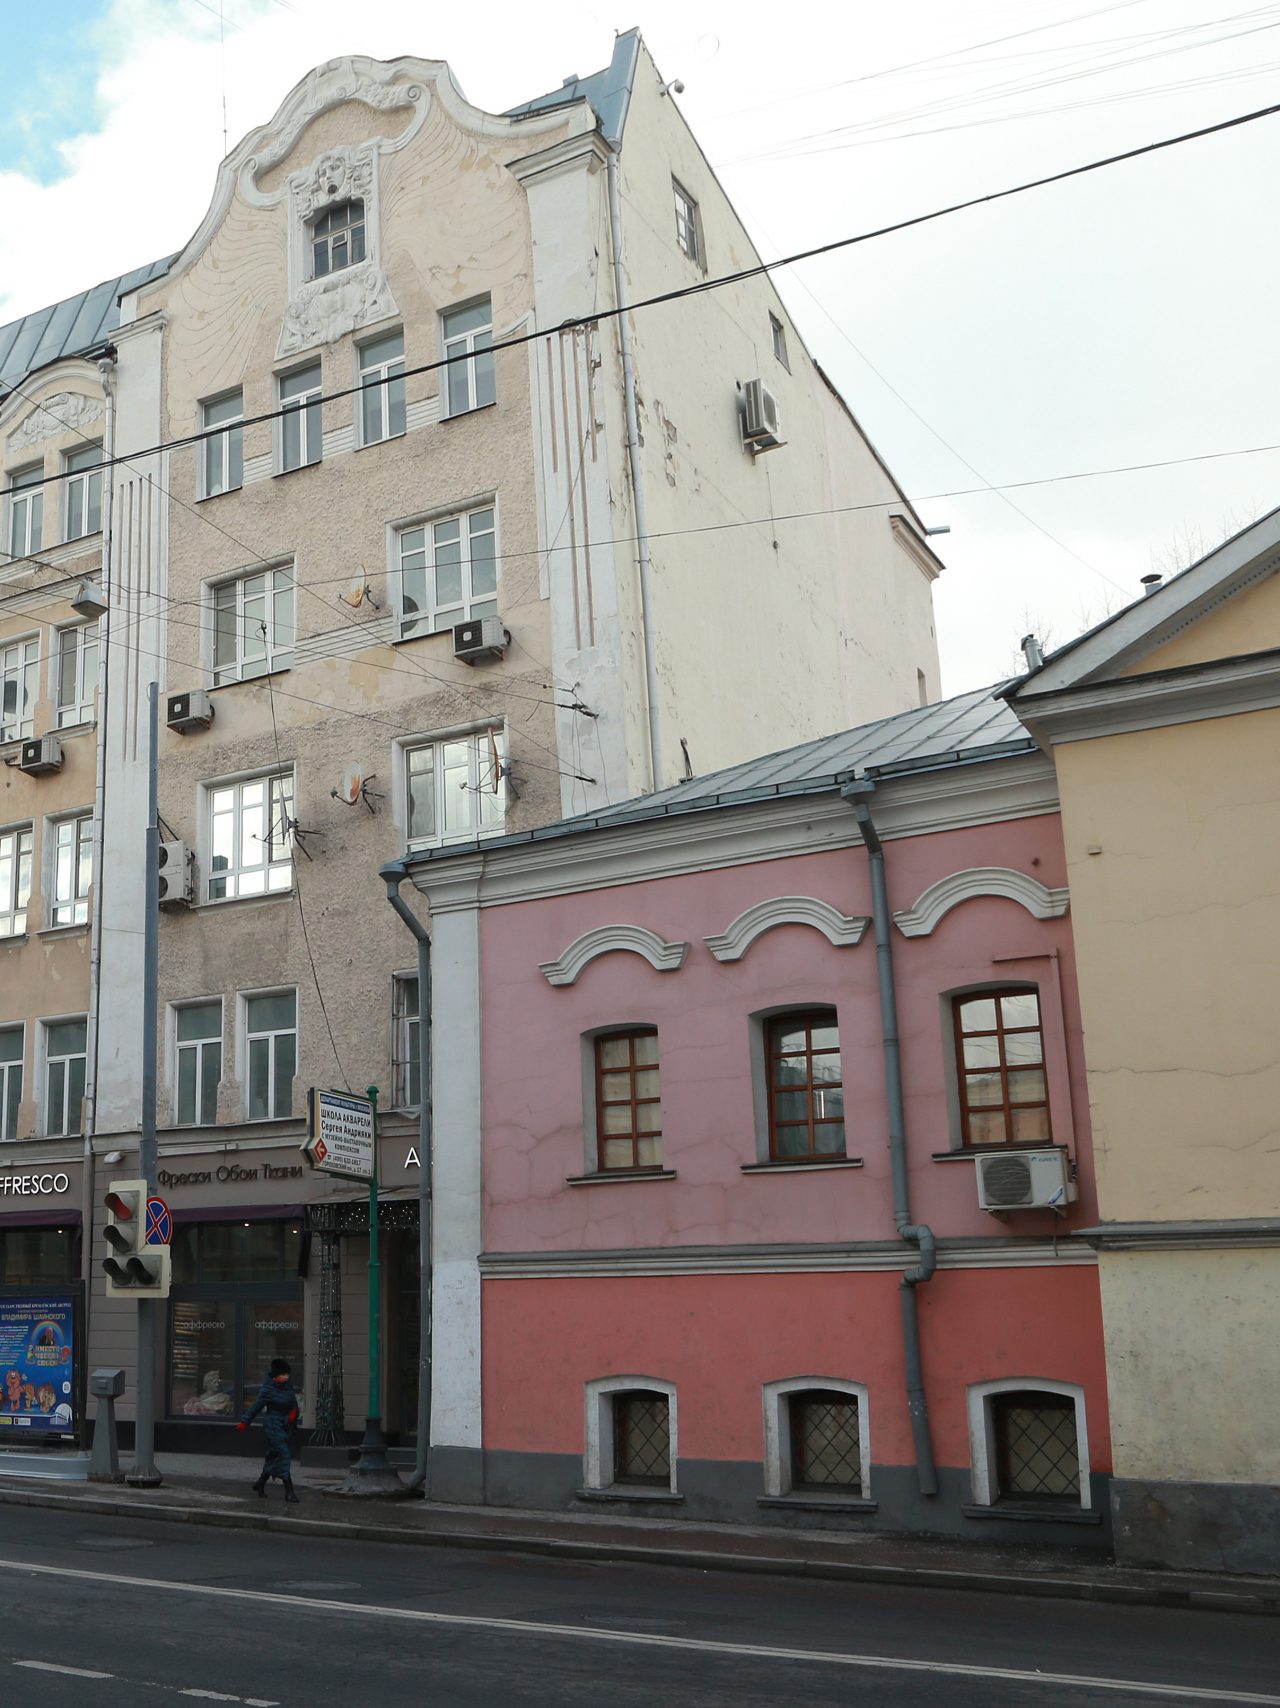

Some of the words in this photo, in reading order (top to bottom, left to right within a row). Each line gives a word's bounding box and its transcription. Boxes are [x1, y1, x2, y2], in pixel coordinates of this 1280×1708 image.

[320, 1108, 342, 1121] ШКОЛА
[343, 1114, 371, 1127] АКВАРЕЛИ
[321, 1120, 343, 1134] Сергея
[343, 1125, 371, 1139] Андрияки
[157, 1169, 212, 1189] Фрески
[216, 1164, 258, 1182] Обои
[261, 1163, 303, 1180] Ткани
[1, 1314, 32, 1322] ВЛАДИМИРА
[183, 1320, 225, 1331] аффреско
[254, 1320, 299, 1331] аффреско
